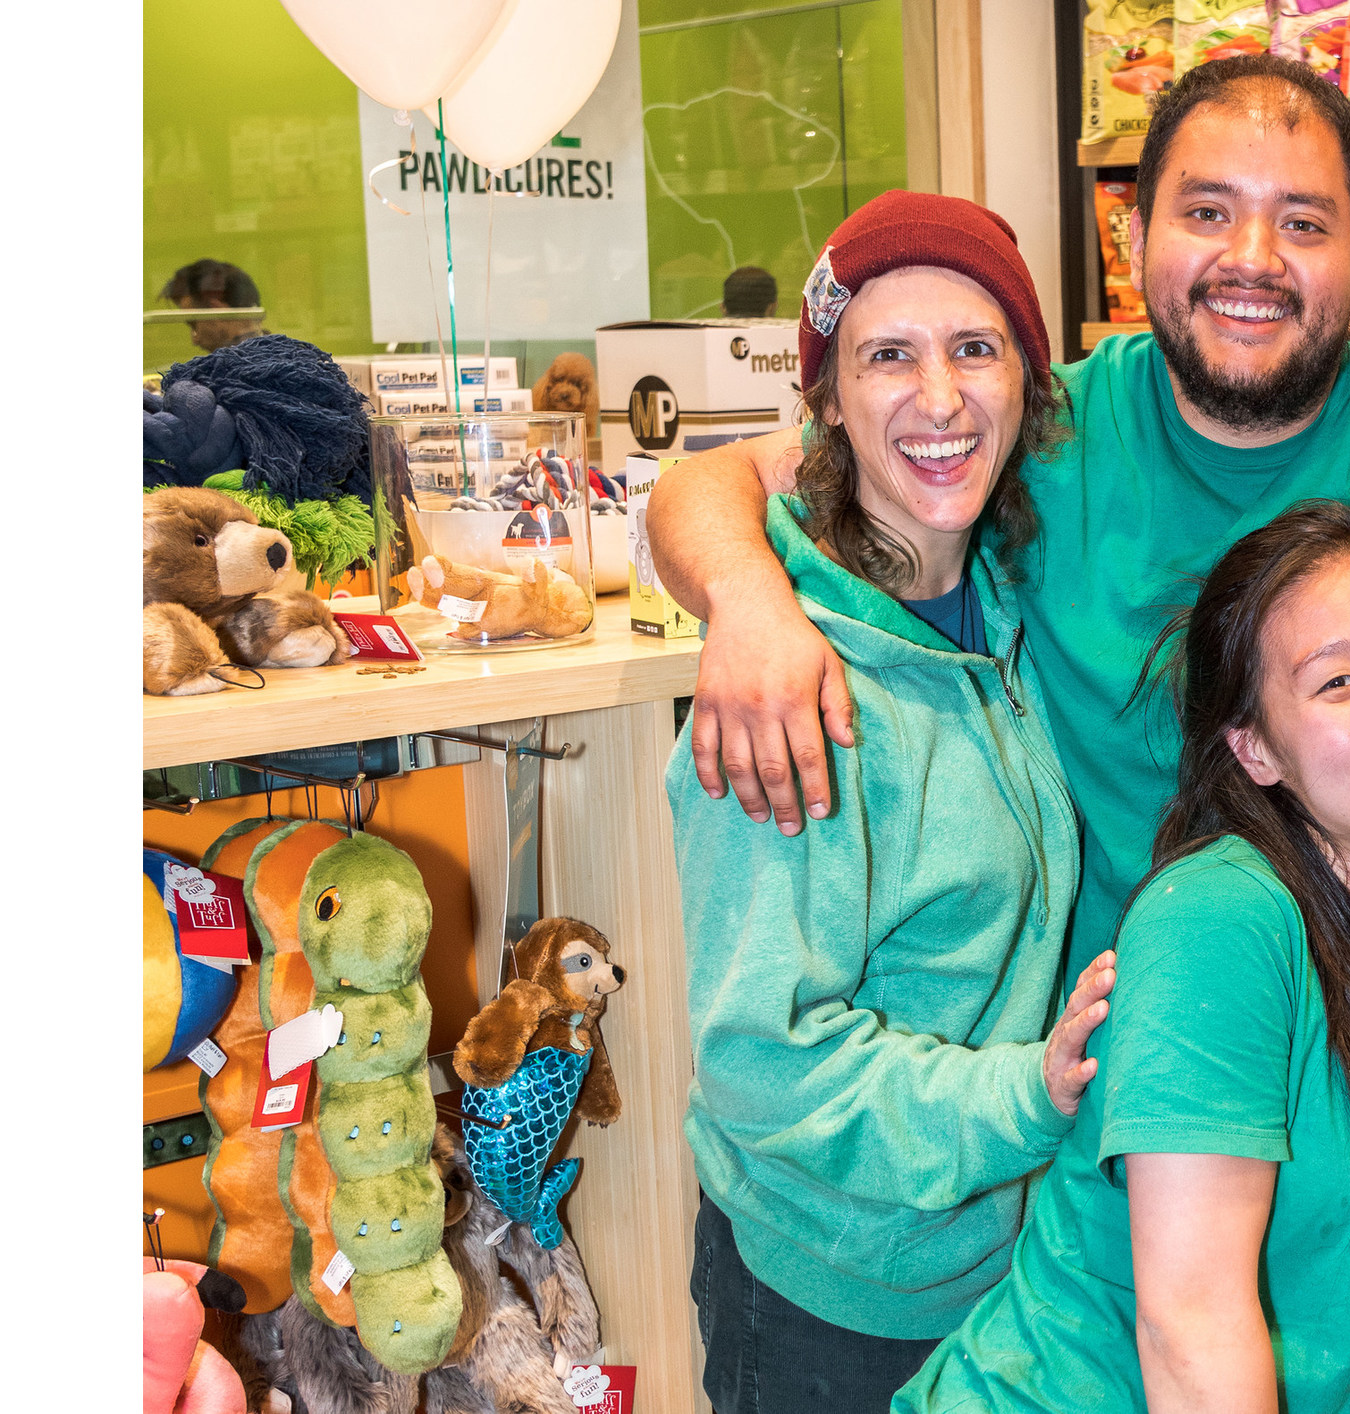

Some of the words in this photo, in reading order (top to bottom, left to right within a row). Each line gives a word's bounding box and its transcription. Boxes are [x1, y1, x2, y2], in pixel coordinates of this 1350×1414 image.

[1114, 119, 1150, 132] CHICKE
[732, 338, 750, 359] MP
[751, 348, 799, 374] metr
[376, 372, 400, 385] Cool
[402, 372, 418, 383] Pet
[420, 371, 438, 383] Pad
[386, 403, 411, 415] Cool
[413, 403, 430, 414] Pet
[631, 390, 678, 439] MP
[580, 1382, 600, 1398] fun!
